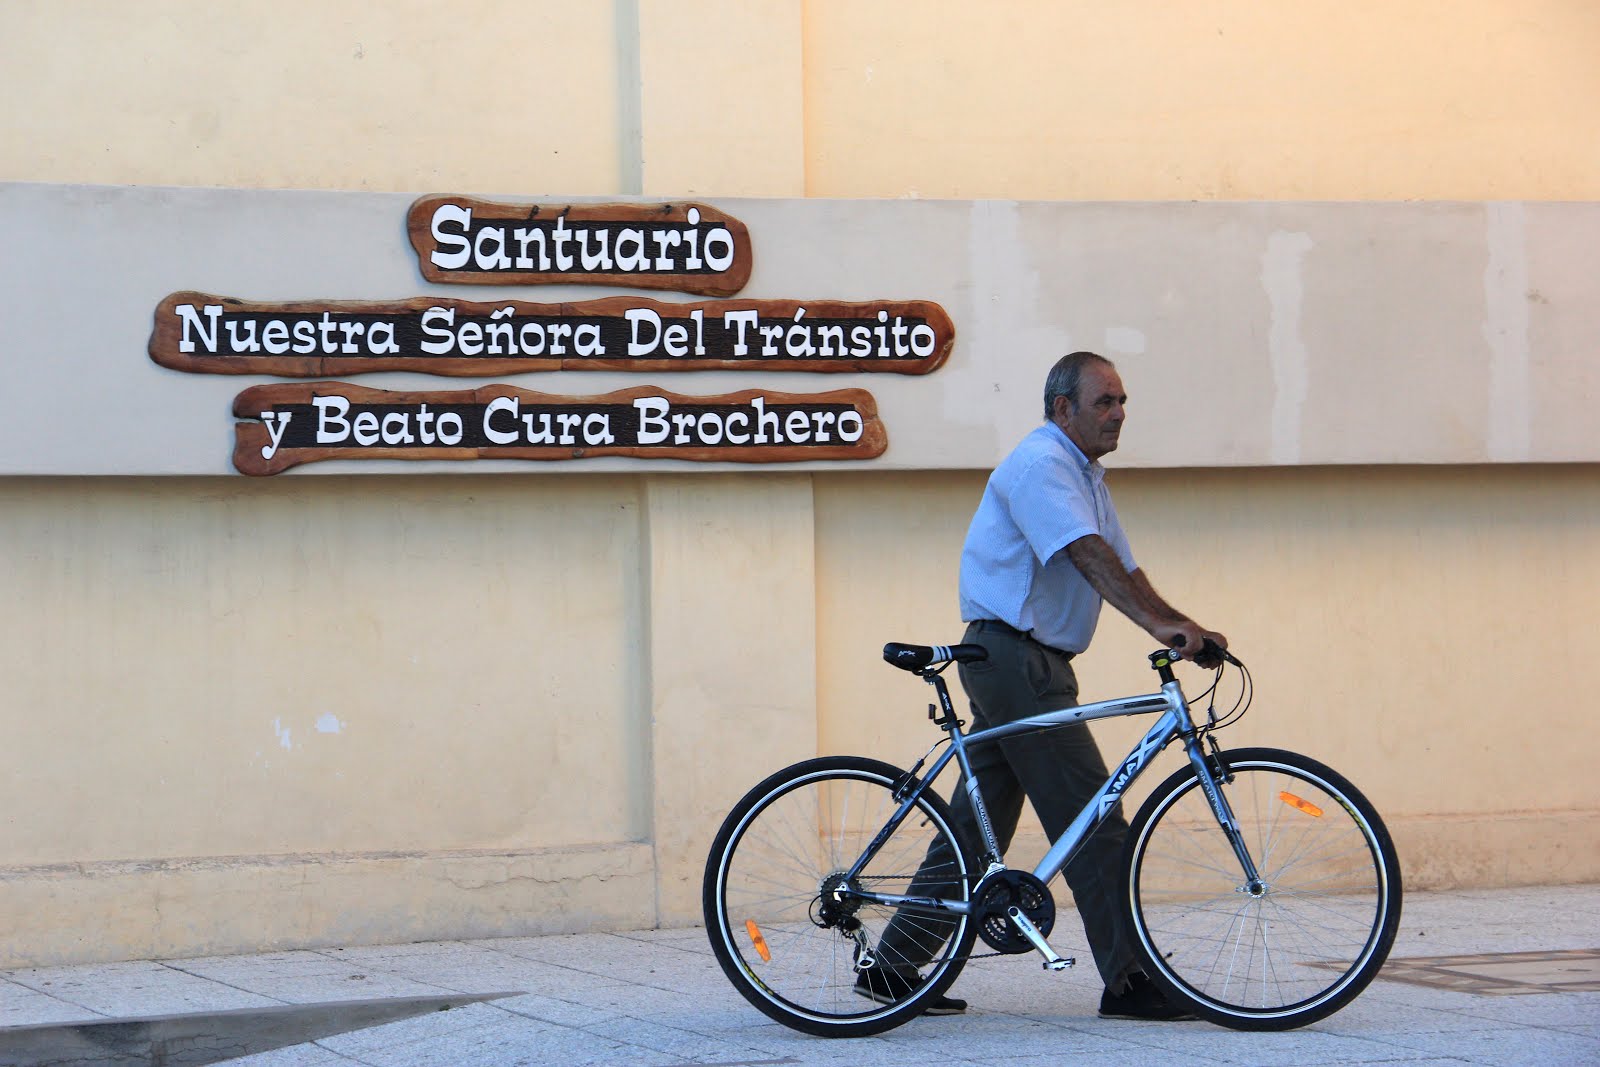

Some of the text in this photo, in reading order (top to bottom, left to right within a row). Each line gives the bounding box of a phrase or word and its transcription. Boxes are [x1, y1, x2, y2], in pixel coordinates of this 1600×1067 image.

[430, 204, 735, 273] Santuario
[175, 304, 936, 357] Nuestra Señora Del Tránsito
[260, 395, 864, 460] y Beato Cura Brochero
